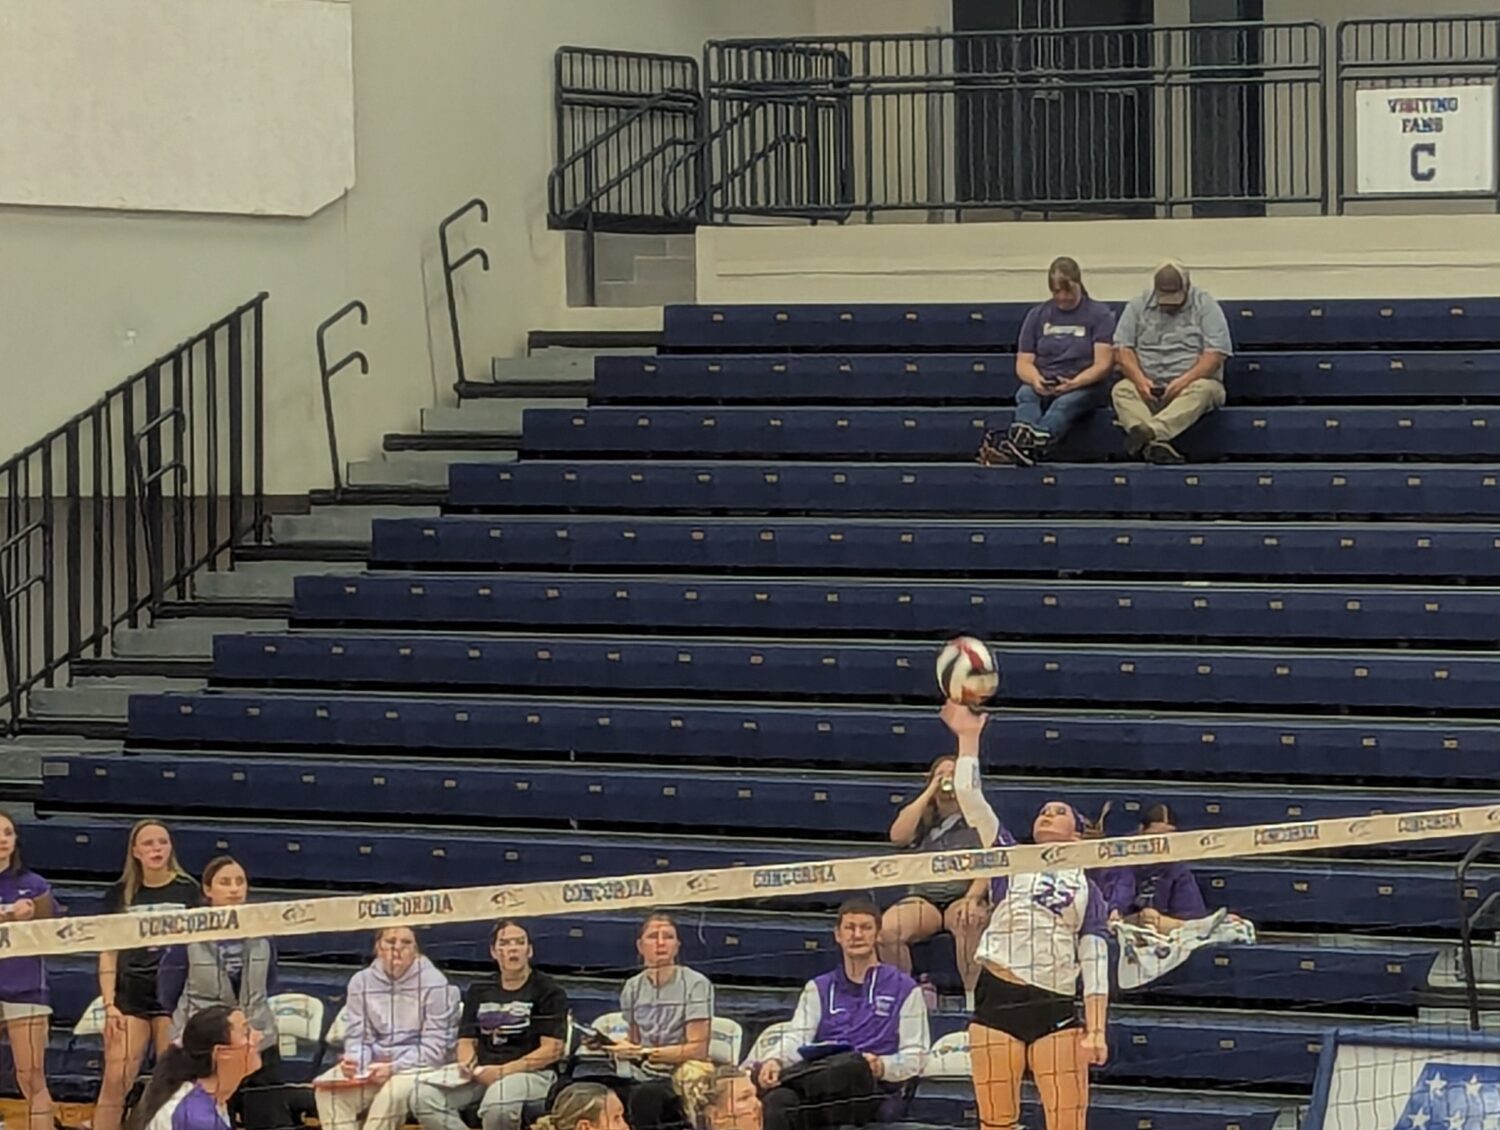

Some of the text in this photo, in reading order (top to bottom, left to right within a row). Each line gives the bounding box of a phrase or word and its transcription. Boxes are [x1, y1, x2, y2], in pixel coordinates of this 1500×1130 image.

[1402, 117, 1443, 133] FANS
[1410, 143, 1436, 181] C
[139, 909, 239, 938] CONCORDIA
[358, 892, 453, 919] CONCORDIA
[562, 879, 653, 903] CONCORDIA
